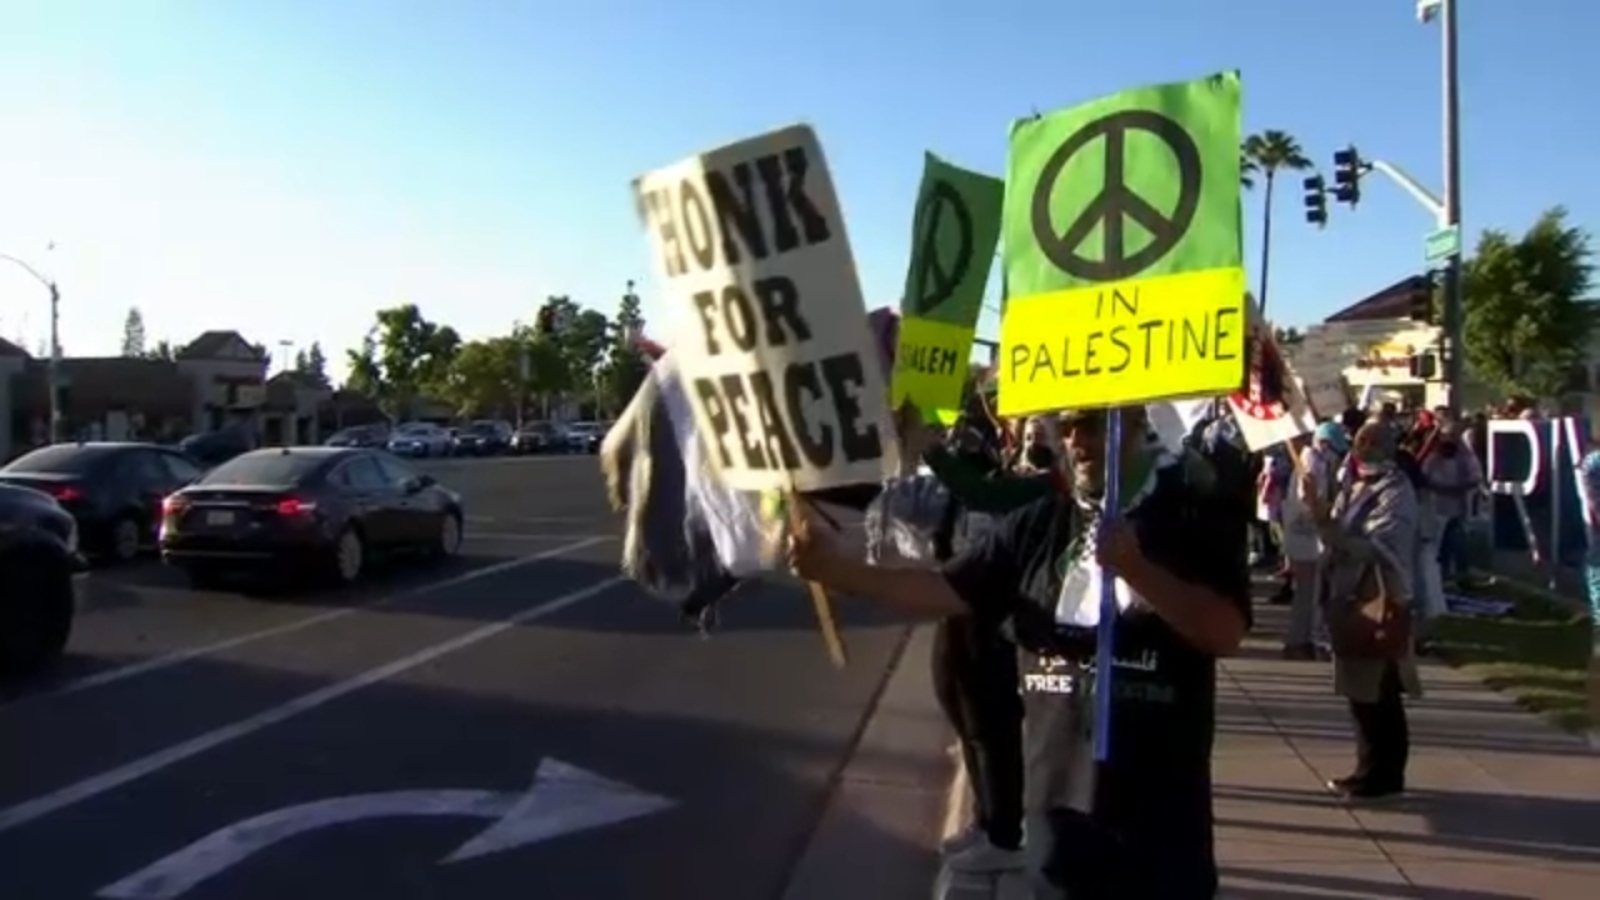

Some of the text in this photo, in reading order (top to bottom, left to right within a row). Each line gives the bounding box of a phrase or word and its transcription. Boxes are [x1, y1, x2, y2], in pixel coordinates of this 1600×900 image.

[643, 147, 832, 277] HONK
[692, 276, 812, 354] FOR
[1095, 286, 1140, 319] IN
[1011, 307, 1238, 382] PALESTINE
[694, 352, 882, 470] PEACE
[1024, 674, 1073, 694] FREE
